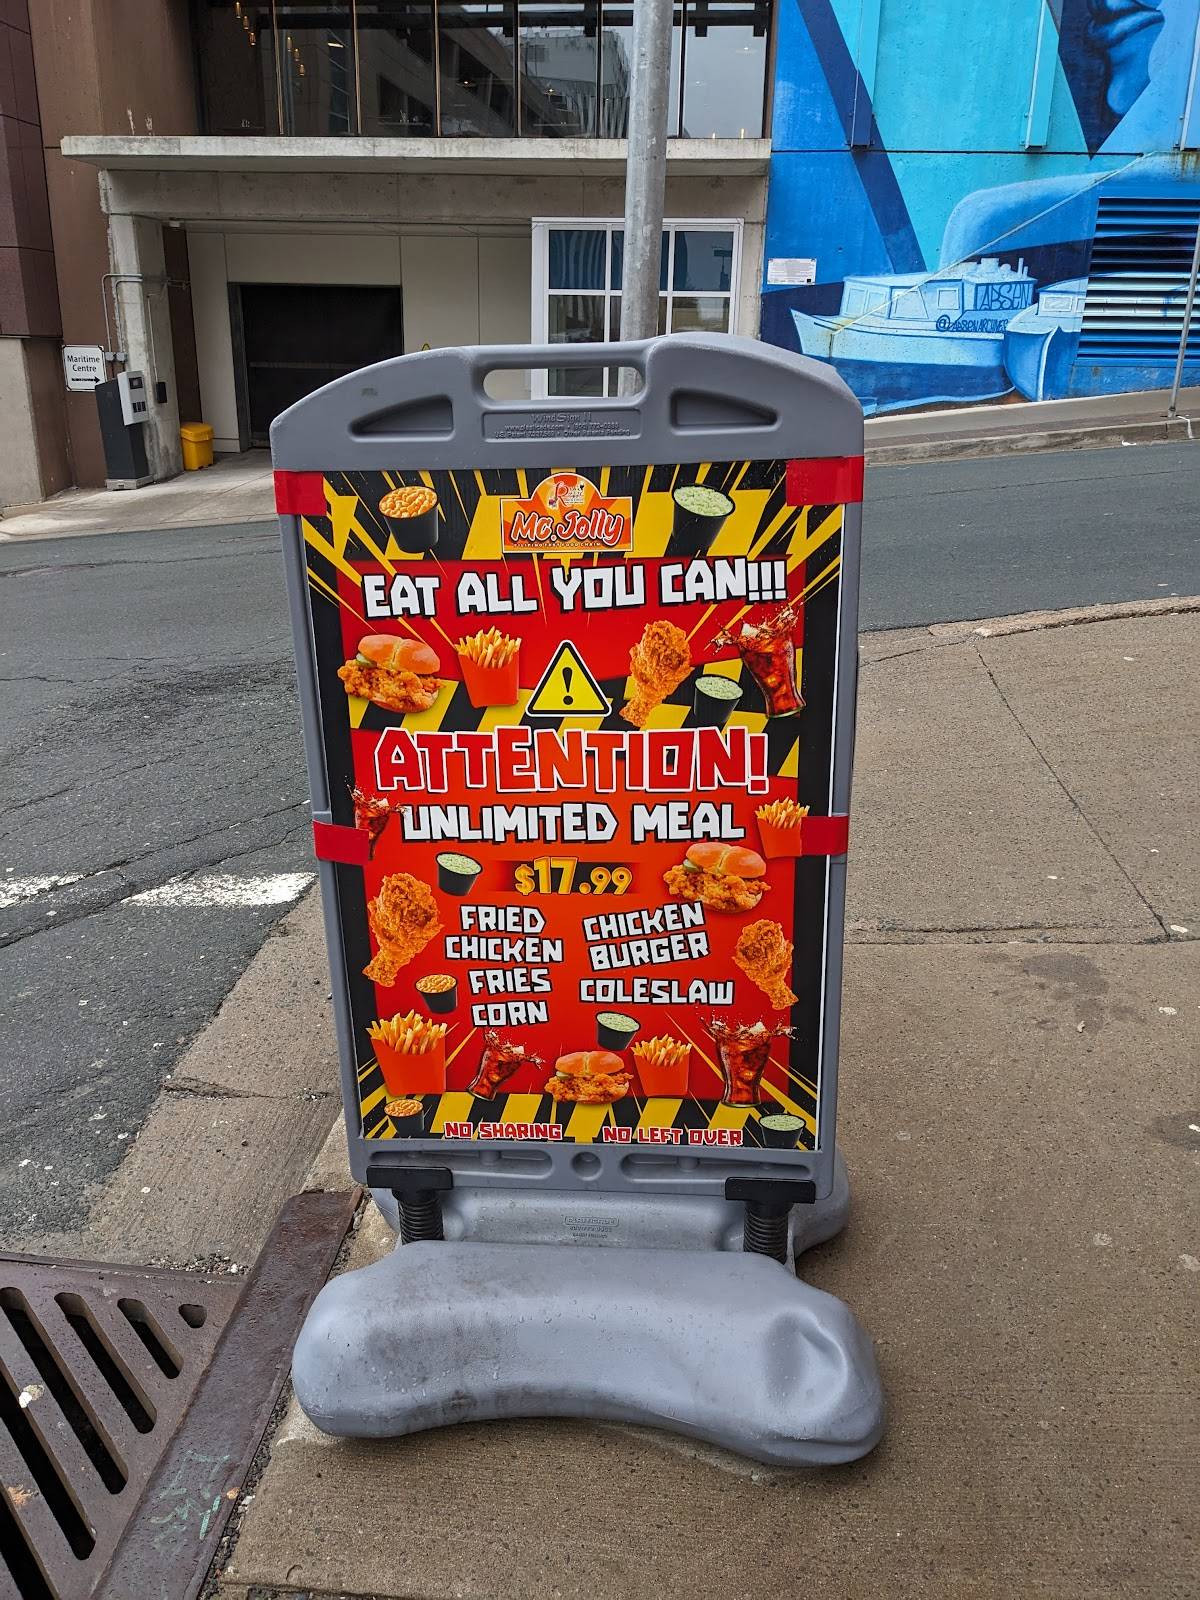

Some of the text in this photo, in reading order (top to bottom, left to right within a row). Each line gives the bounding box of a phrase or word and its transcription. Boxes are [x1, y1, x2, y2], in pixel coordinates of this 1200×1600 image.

[67, 355, 100, 363] Maritime
[72, 364, 97, 372] Centre
[362, 557, 788, 618] EAT ALL YOU CAN!!!
[374, 725, 769, 794] ATTENTION!
[402, 801, 745, 843] UNLIMITED MEAL
[514, 856, 634, 897] $17.99
[459, 904, 547, 934] FRIED
[581, 900, 706, 942] CHICKEN
[444, 935, 564, 963] CHICKEN
[588, 930, 710, 972] BURGER
[468, 967, 553, 995] FRIES
[578, 977, 736, 1006] COLESLAW
[470, 1000, 549, 1028] CORN
[444, 1122, 564, 1140] NO SHARING
[602, 1126, 744, 1146] NO LEFT OVER
